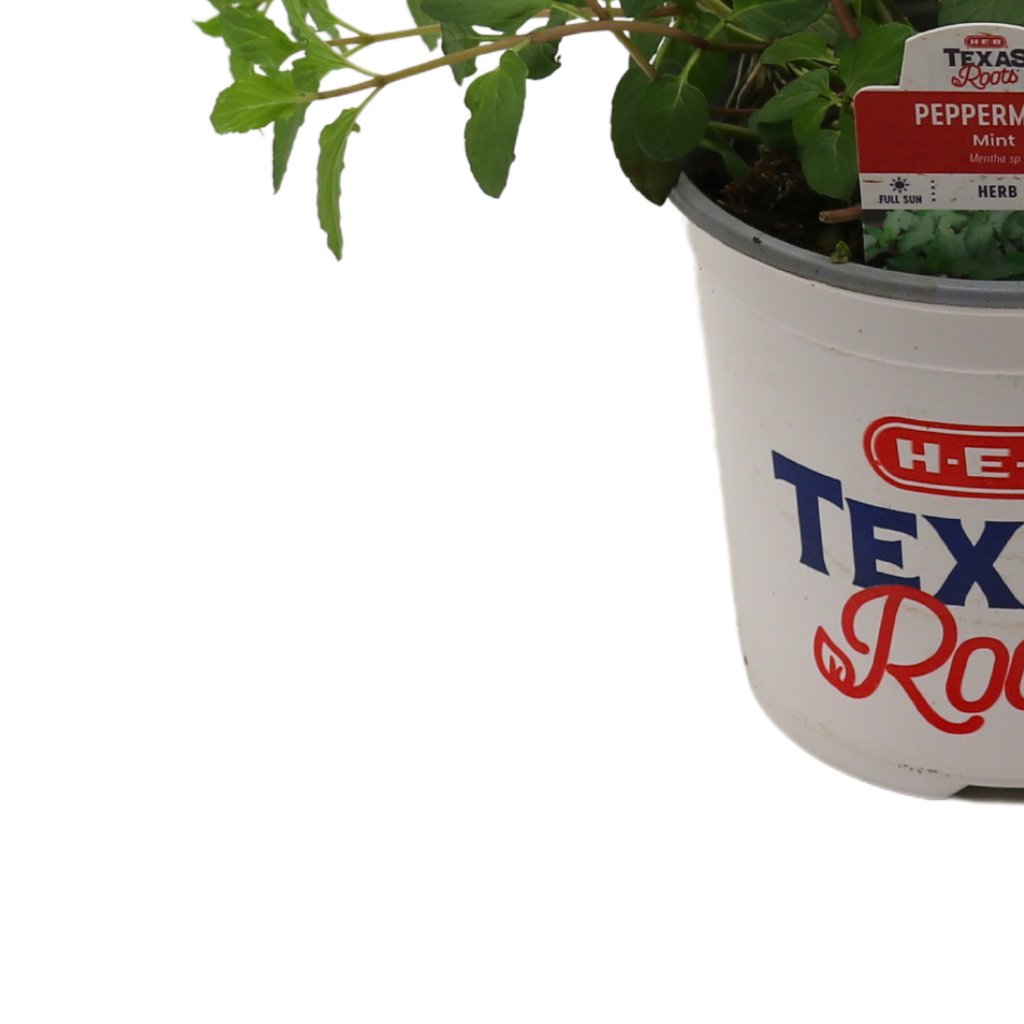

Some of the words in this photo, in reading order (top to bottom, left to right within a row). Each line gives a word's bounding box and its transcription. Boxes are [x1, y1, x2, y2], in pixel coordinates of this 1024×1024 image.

[951, 64, 1019, 90] Roots
[972, 134, 1016, 147] Mint
[968, 153, 1006, 163] Mentha
[978, 185, 1018, 199] HERB
[878, 195, 900, 204] FULL
[903, 195, 922, 204] SUN
